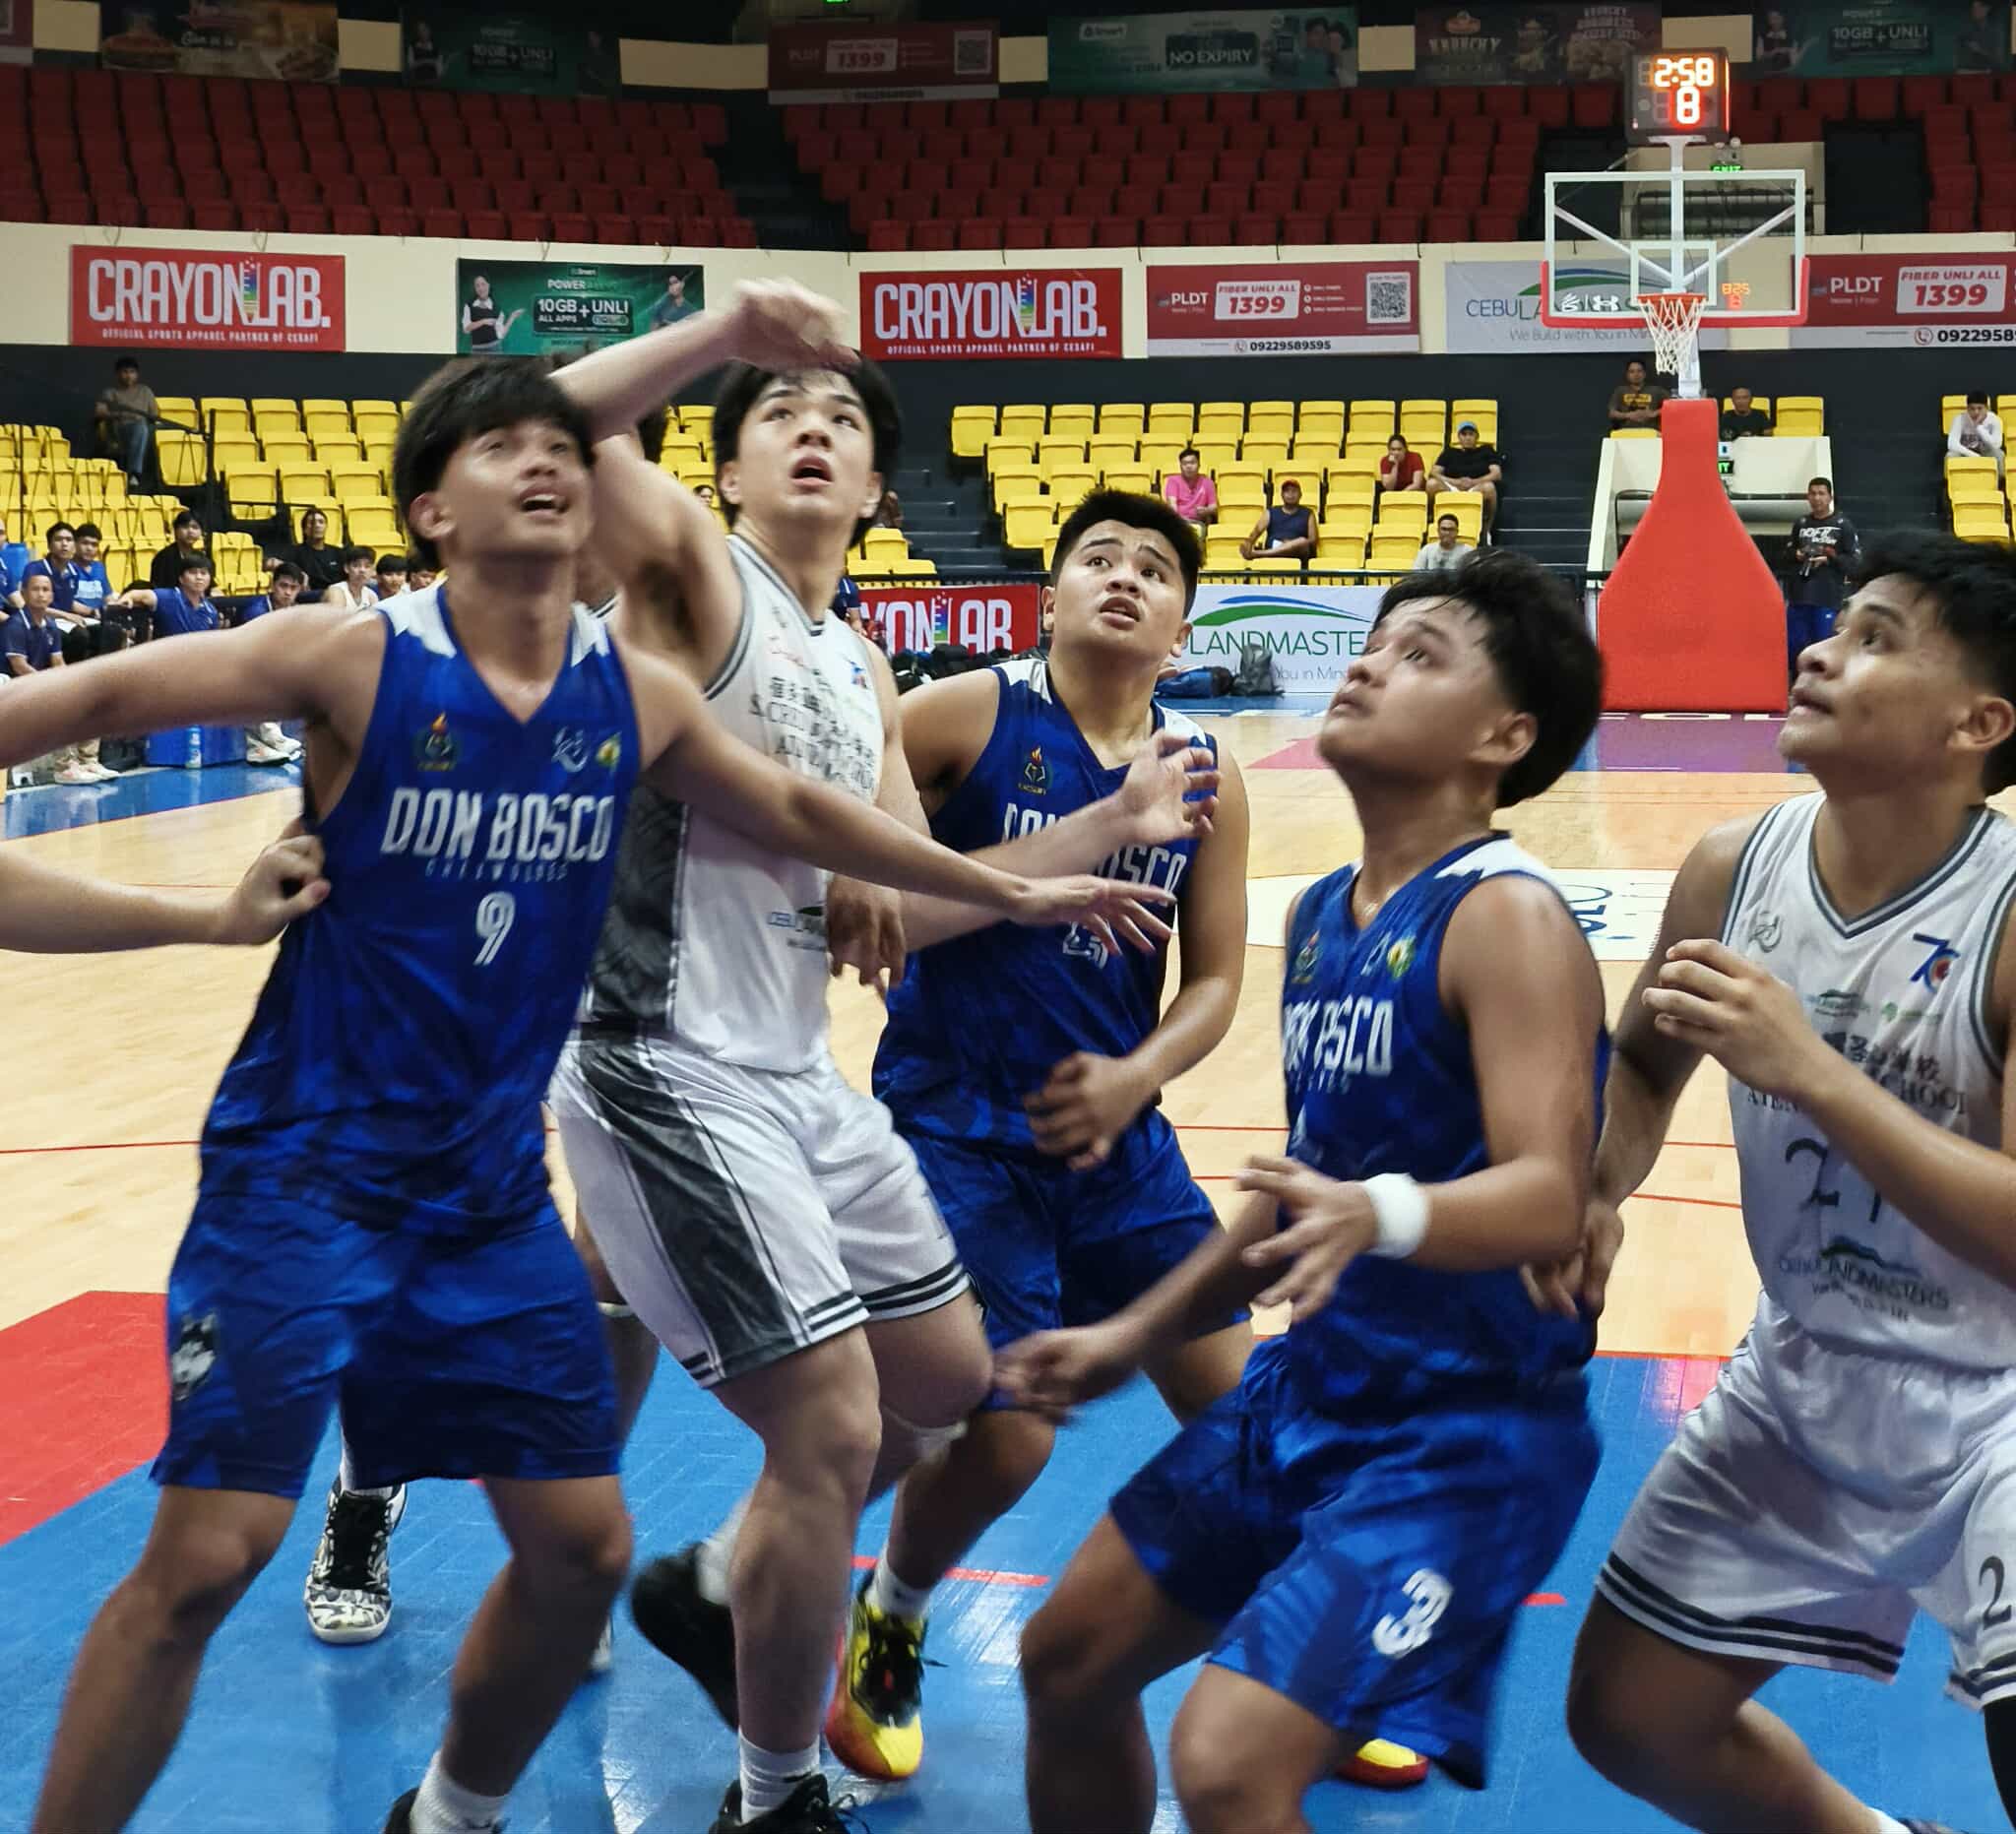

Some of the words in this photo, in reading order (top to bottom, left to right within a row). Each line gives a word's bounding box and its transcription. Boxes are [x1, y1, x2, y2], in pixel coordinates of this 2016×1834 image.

[1831, 27, 1873, 40] 10GB
[1889, 24, 1928, 40] UNLI
[837, 50, 886, 68] 1399
[1169, 50, 1196, 66] NO
[1197, 48, 1253, 65] EXPIRY
[1654, 57, 1715, 88] 2:58
[1676, 86, 1701, 124] 8
[1901, 271, 1939, 282] FIBER
[1943, 271, 1974, 281] UNLI
[1978, 270, 2001, 280] ALL
[547, 280, 586, 290] POWER
[1251, 285, 1276, 293] UNLI
[1278, 284, 1297, 292] ALL
[1829, 277, 1883, 294] PLDT
[1170, 292, 1209, 305] PLDT
[1915, 284, 1987, 307] 1399
[537, 298, 578, 314] 10GB
[592, 298, 629, 314] UNLI
[1228, 295, 1286, 315] 1399
[102, 328, 145, 340] OFFICIAL
[148, 329, 184, 341] SPORTS
[185, 330, 226, 342] APPAREL
[228, 331, 270, 343] PARTNER
[273, 333, 284, 343] OF
[1510, 328, 1529, 342] We
[1532, 328, 1560, 342] Build
[1563, 328, 1592, 341] with
[1593, 328, 1614, 341] You
[1937, 329, 2016, 343] 0922958
[887, 345, 927, 355] OFFICIAL
[930, 345, 963, 354] SPORTS
[966, 344, 1004, 354] APPAREL
[1007, 343, 1046, 353] PARTNER
[1049, 343, 1060, 352] OF
[1063, 342, 1095, 352] CESAFI
[1249, 340, 1332, 351] 09229589595
[1189, 630, 1372, 656] LANDMASTE
[380, 787, 484, 859] DON
[486, 791, 615, 862] BOSCO
[472, 890, 517, 966] 9
[1978, 1554, 2013, 1631] 2
[1371, 1566, 1454, 1661] 3
